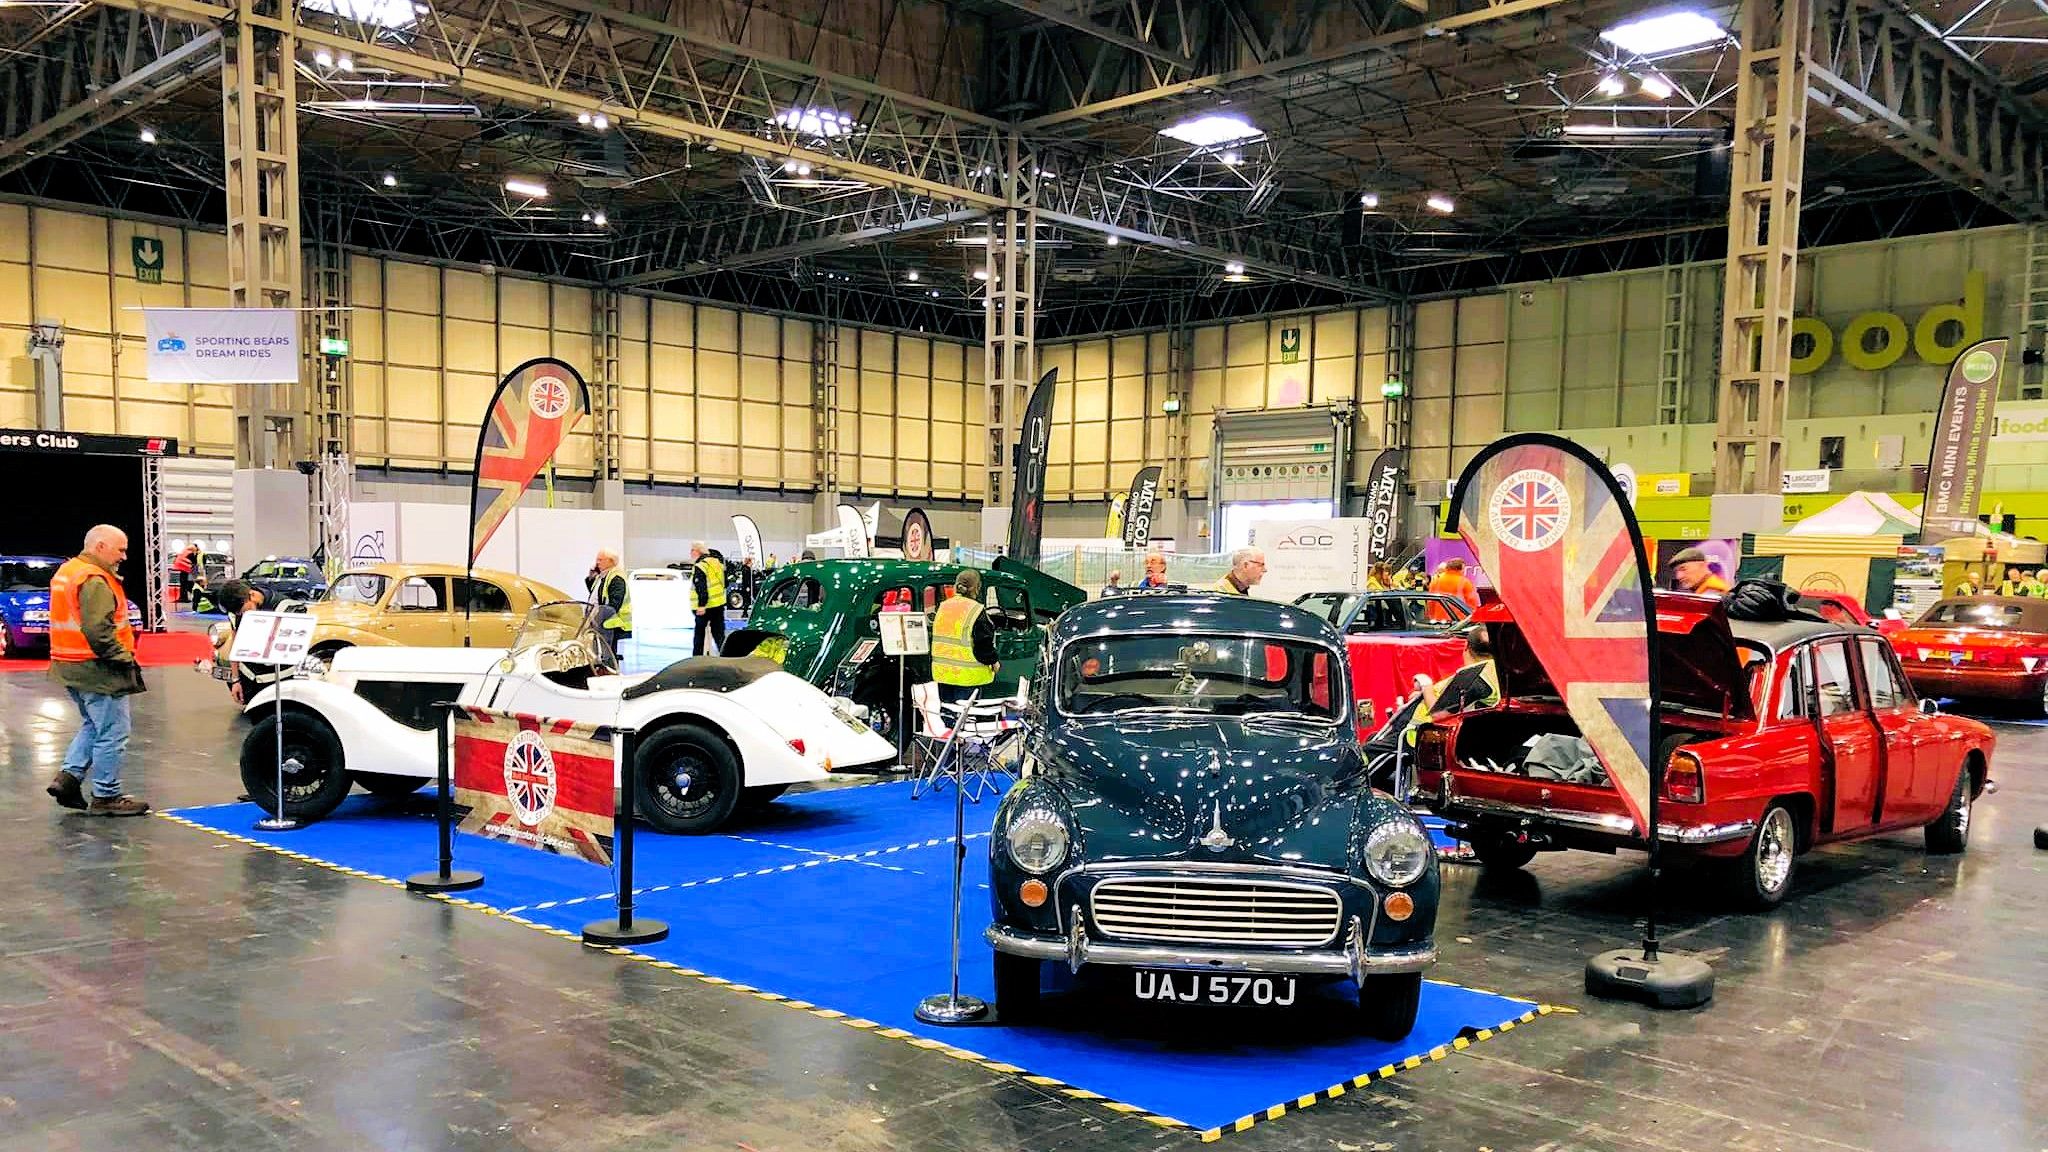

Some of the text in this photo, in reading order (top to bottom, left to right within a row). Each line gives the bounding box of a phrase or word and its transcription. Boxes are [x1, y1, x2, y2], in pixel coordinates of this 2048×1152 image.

[138, 270, 160, 282] EXIT
[195, 337, 290, 346] SPORTING BEARS
[196, 349, 272, 358] DREAM RIDES
[0, 433, 80, 449] ers Club
[1936, 386, 1968, 513] BMC MINI EVENTS
[1960, 474, 1977, 514] Bringing
[1973, 388, 1988, 439] together
[1134, 479, 1157, 548] MK1 GOL
[1370, 465, 1398, 559] MK1 GOLF
[1135, 971, 1296, 1006] UAJ 570J
